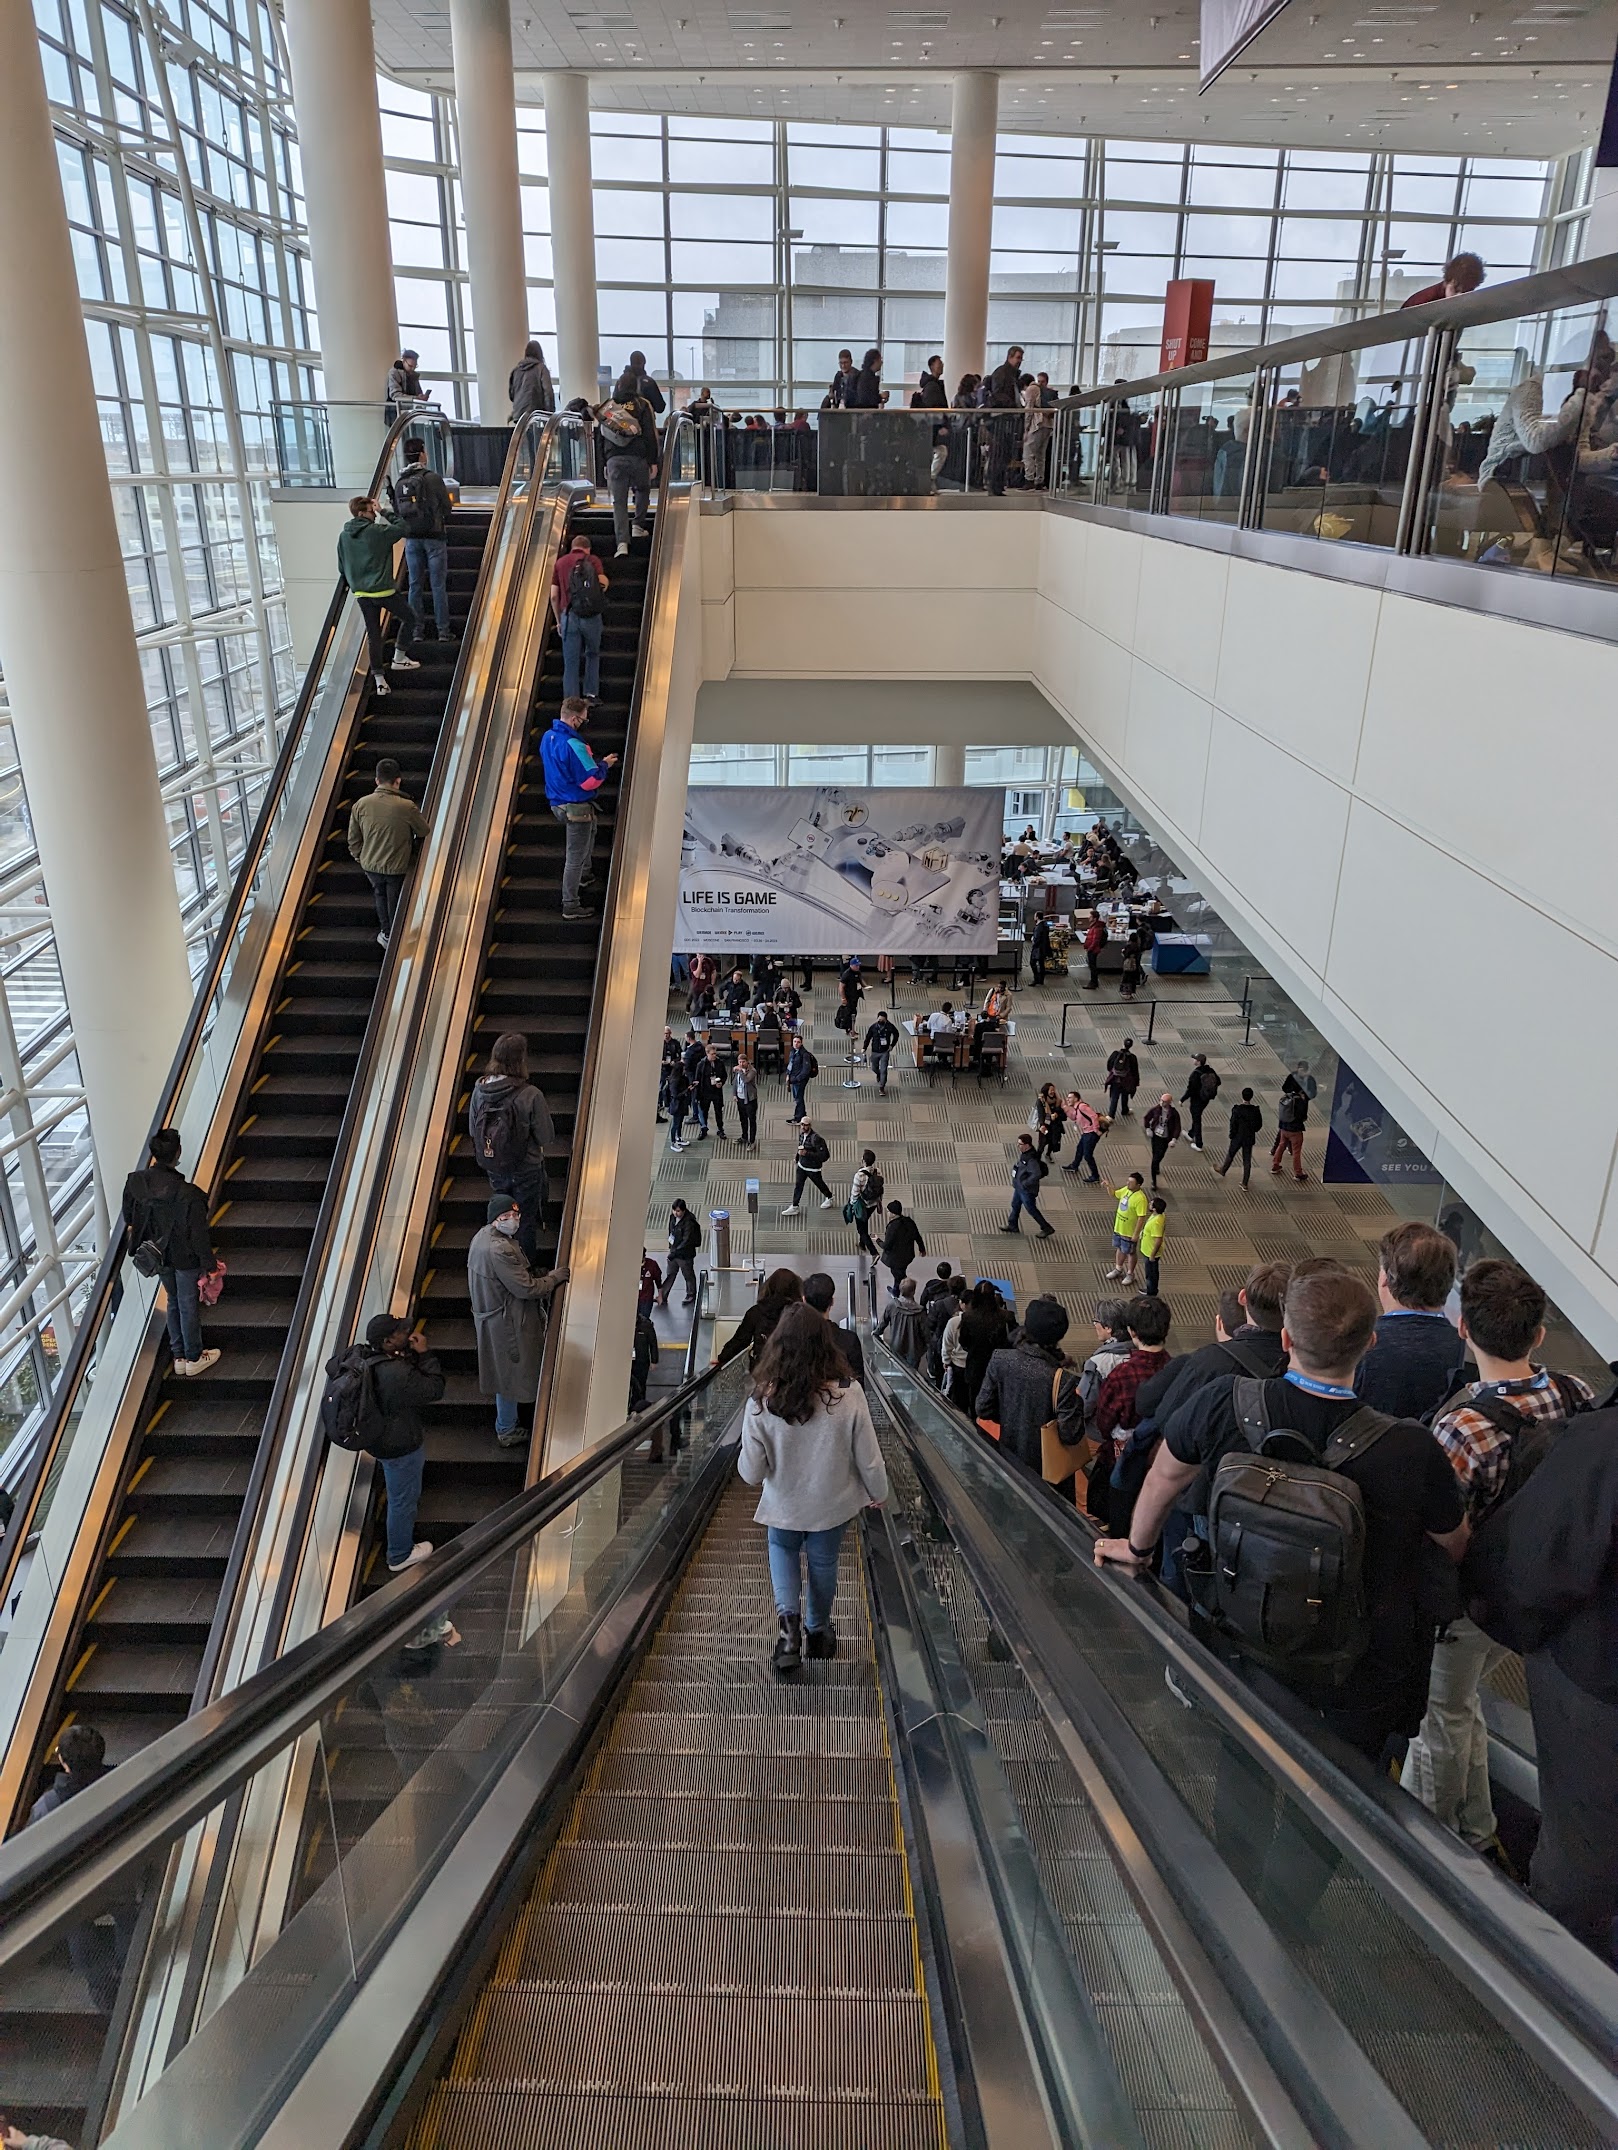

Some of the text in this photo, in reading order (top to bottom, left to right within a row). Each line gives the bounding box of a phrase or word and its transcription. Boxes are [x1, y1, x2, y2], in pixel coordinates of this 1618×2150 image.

[1165, 338, 1182, 350] SHUT
[1189, 338, 1206, 349] COME
[1167, 350, 1177, 361] UP
[683, 891, 777, 905] LIFE IS GAME
[1381, 1163, 1402, 1172] SEE
[1405, 1164, 1428, 1172] YOU
